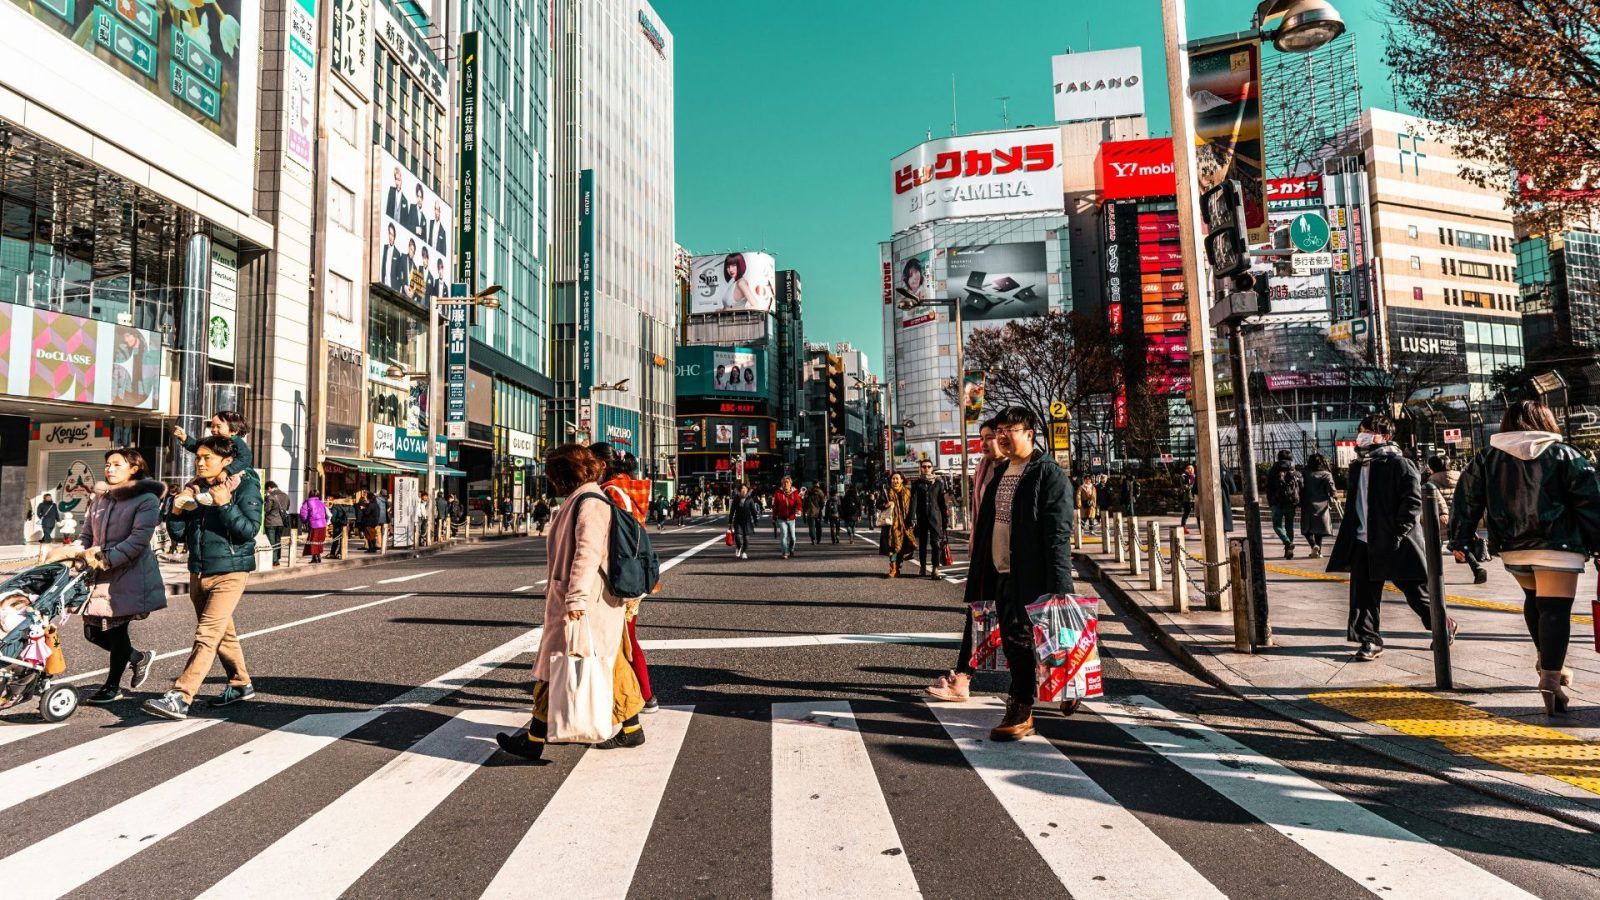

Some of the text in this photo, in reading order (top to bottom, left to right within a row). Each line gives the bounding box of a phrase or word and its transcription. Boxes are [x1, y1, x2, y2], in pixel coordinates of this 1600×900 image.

[1053, 75, 1139, 94] TAKANO
[464, 97, 473, 151] 三井住友銀行
[895, 144, 1054, 194] ビックカメラ
[1109, 162, 1174, 177] Y!mobi
[938, 181, 1032, 203] CAMERA
[1294, 256, 1331, 266] 歩行者優先
[699, 272, 718, 290] Spa
[1400, 336, 1439, 354] LUSH
[36, 348, 92, 366] DoCLASSE
[1054, 403, 1064, 415] 2
[606, 425, 631, 438] MIZUHO
[396, 437, 428, 454] AOYAM
[513, 437, 532, 450] GUCCI
